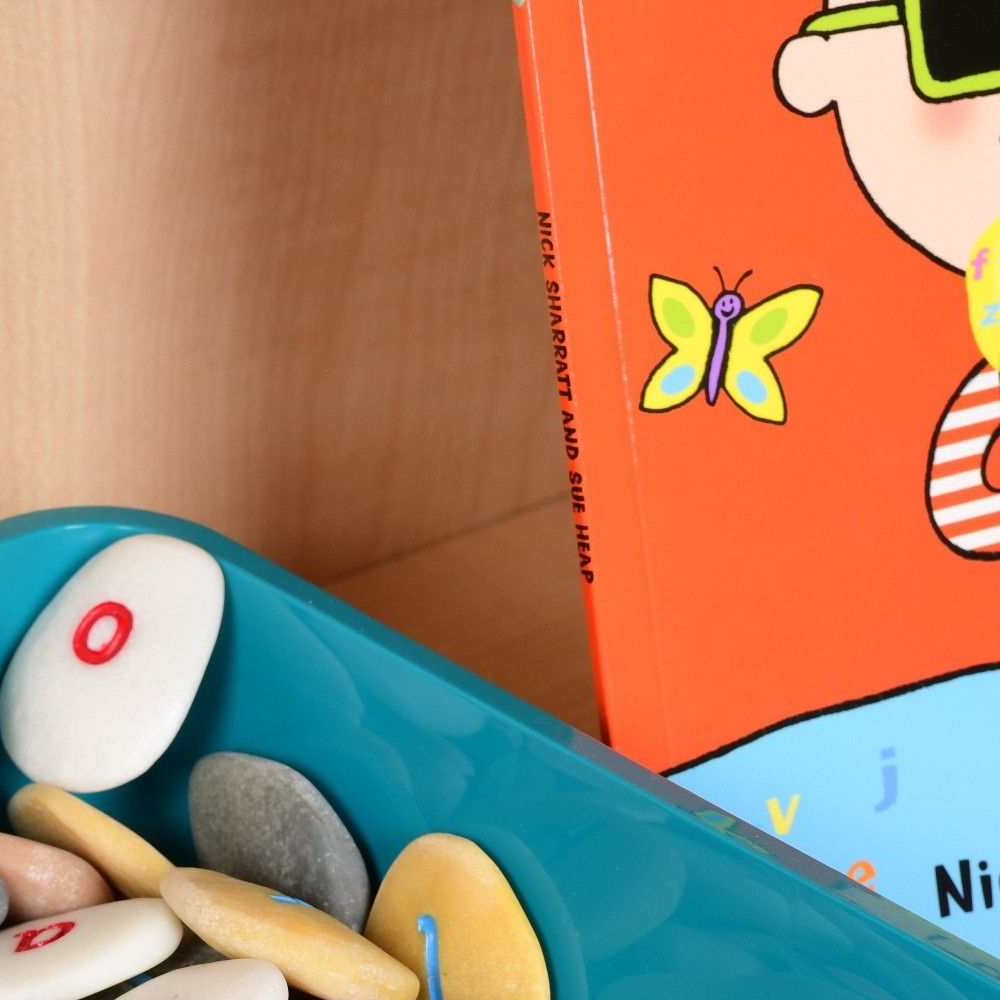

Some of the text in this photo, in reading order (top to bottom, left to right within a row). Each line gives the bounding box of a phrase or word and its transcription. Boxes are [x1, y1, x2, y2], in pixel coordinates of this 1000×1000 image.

[537, 211, 595, 584] NICK SHARRATT AND SUE HEAP
